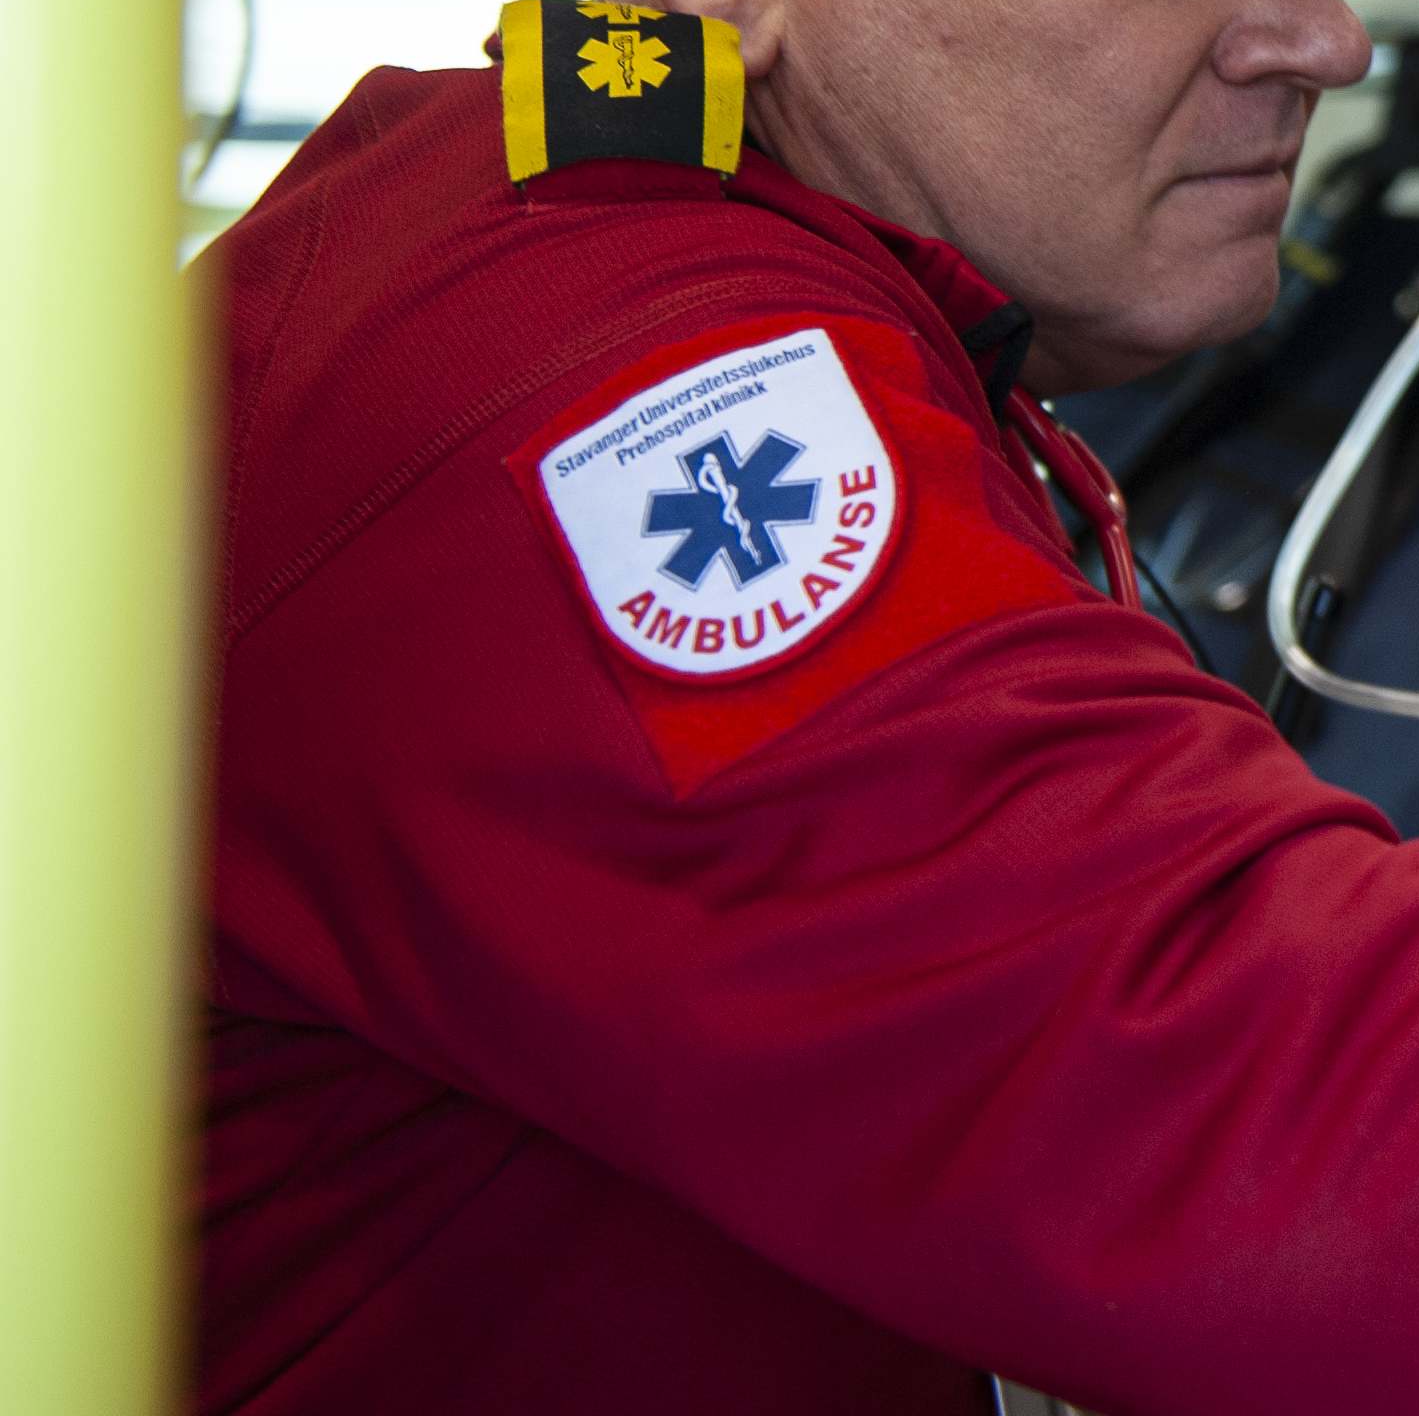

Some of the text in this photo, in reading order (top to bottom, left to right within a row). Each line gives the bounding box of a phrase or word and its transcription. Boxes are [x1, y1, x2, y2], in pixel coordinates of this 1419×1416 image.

[555, 343, 816, 478] Stavanger Universitetssjukehus
[614, 381, 768, 467] Prehospital klinikk
[618, 465, 876, 654] AMBULANSE
